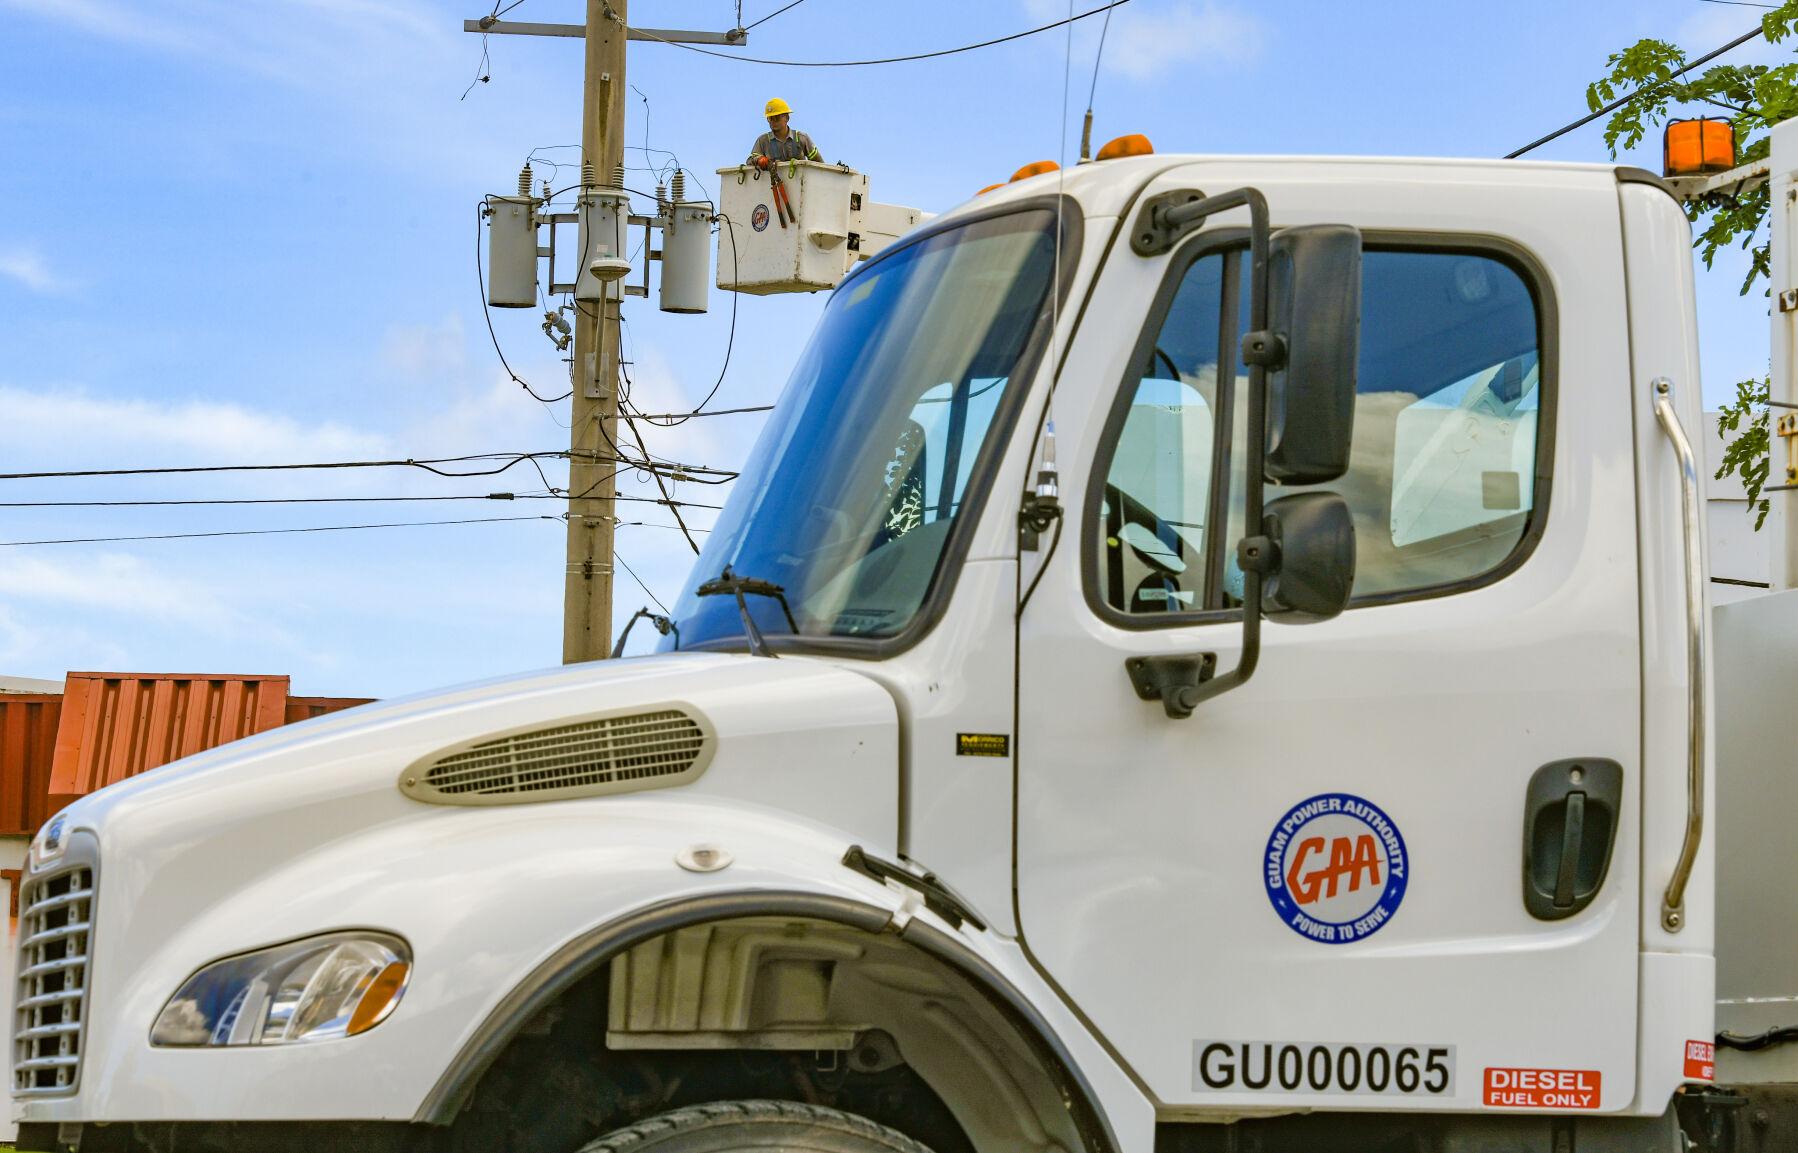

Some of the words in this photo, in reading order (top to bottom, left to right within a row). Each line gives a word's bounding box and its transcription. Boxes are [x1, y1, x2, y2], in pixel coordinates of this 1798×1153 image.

[1268, 831, 1288, 889] GUAM
[1282, 798, 1342, 834] POWER
[1343, 800, 1404, 879] AUTHORITY
[1287, 834, 1385, 906] GPA
[1292, 913, 1335, 941] POWER
[1338, 924, 1355, 940] TO
[1354, 905, 1390, 936] SERVE
[1200, 1042, 1449, 1094] GU000065
[1491, 1070, 1593, 1091] DIESEL
[1490, 1091, 1538, 1105] FUEL
[1542, 1093, 1592, 1107] ONLY
